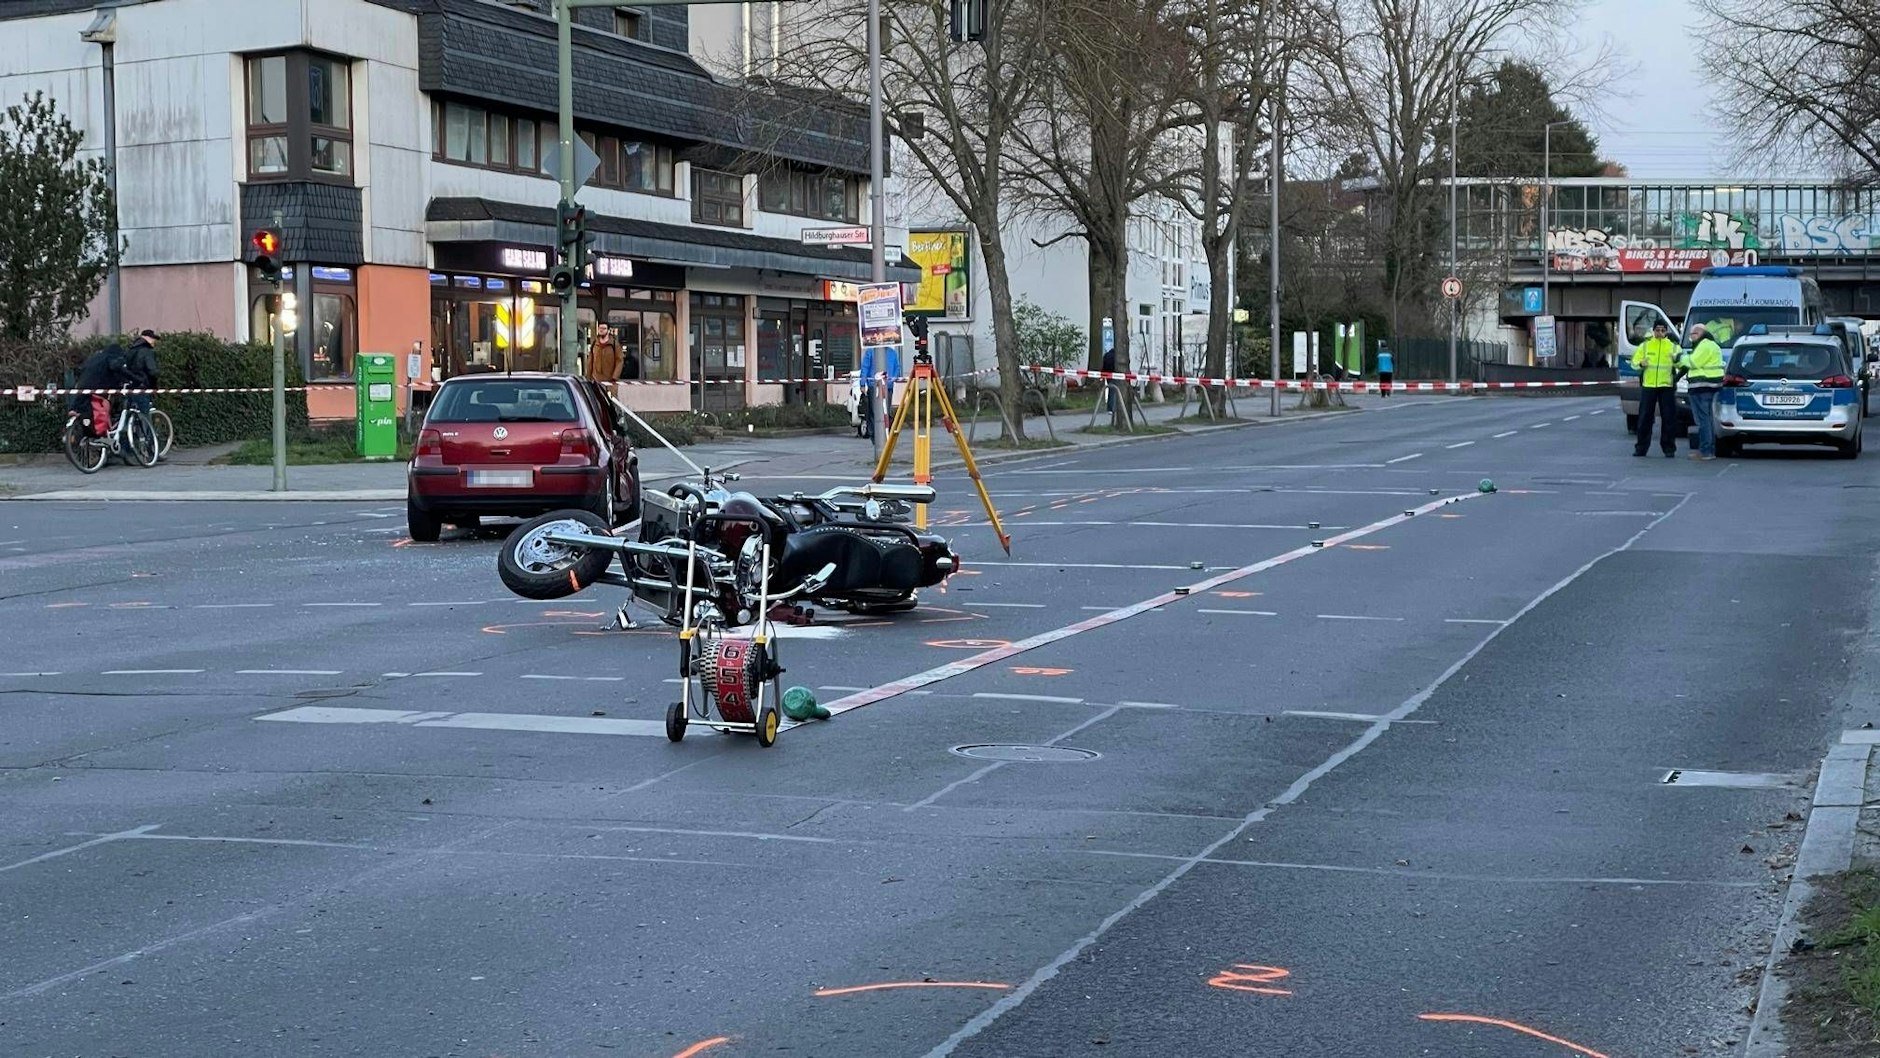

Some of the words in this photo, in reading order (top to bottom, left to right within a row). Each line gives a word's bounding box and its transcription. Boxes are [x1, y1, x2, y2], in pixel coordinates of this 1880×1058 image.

[805, 231, 854, 240] Hildburghauser
[1625, 250, 1655, 259] BIKES
[1659, 250, 1666, 259] &
[1668, 250, 1708, 259] E-BIKES
[1643, 259, 1664, 270] FÜR
[1667, 260, 1691, 270] ALLE
[1696, 299, 1794, 307] VERKEHRSUNFALLKOMMANDO
[377, 417, 392, 426] pin
[722, 645, 740, 660] 6
[720, 667, 739, 685] 5
[723, 691, 741, 706] 4
